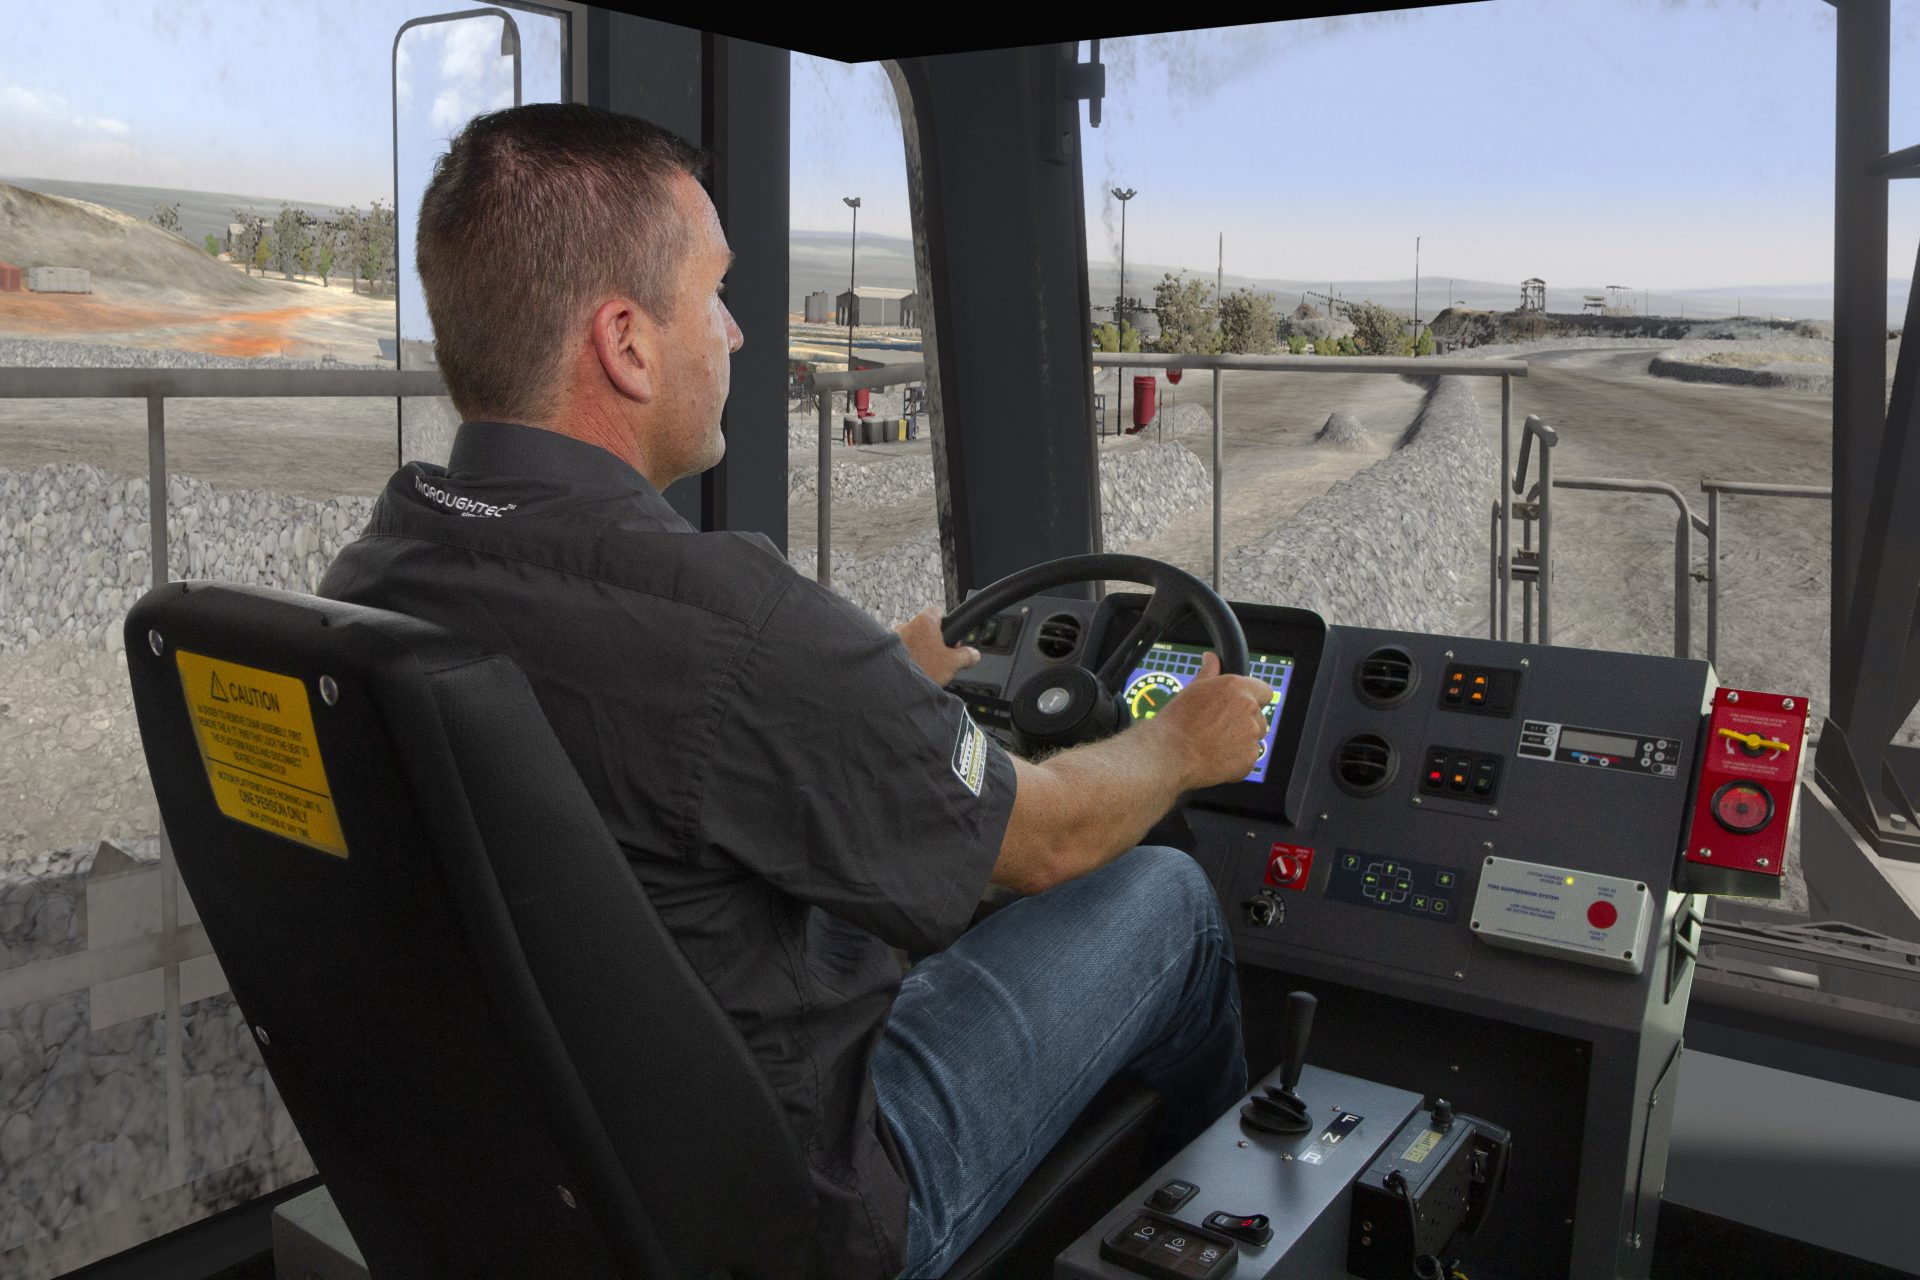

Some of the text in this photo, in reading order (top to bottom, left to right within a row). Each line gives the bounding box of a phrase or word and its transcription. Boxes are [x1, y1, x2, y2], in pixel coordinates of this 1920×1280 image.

[415, 475, 507, 517] THOROUGHTEC
[229, 683, 280, 712] CAUTION
[238, 789, 308, 823] ONE PERSON ONLY
[1341, 1114, 1359, 1122] F
[1322, 1132, 1341, 1143] N
[1303, 1152, 1322, 1163] R
